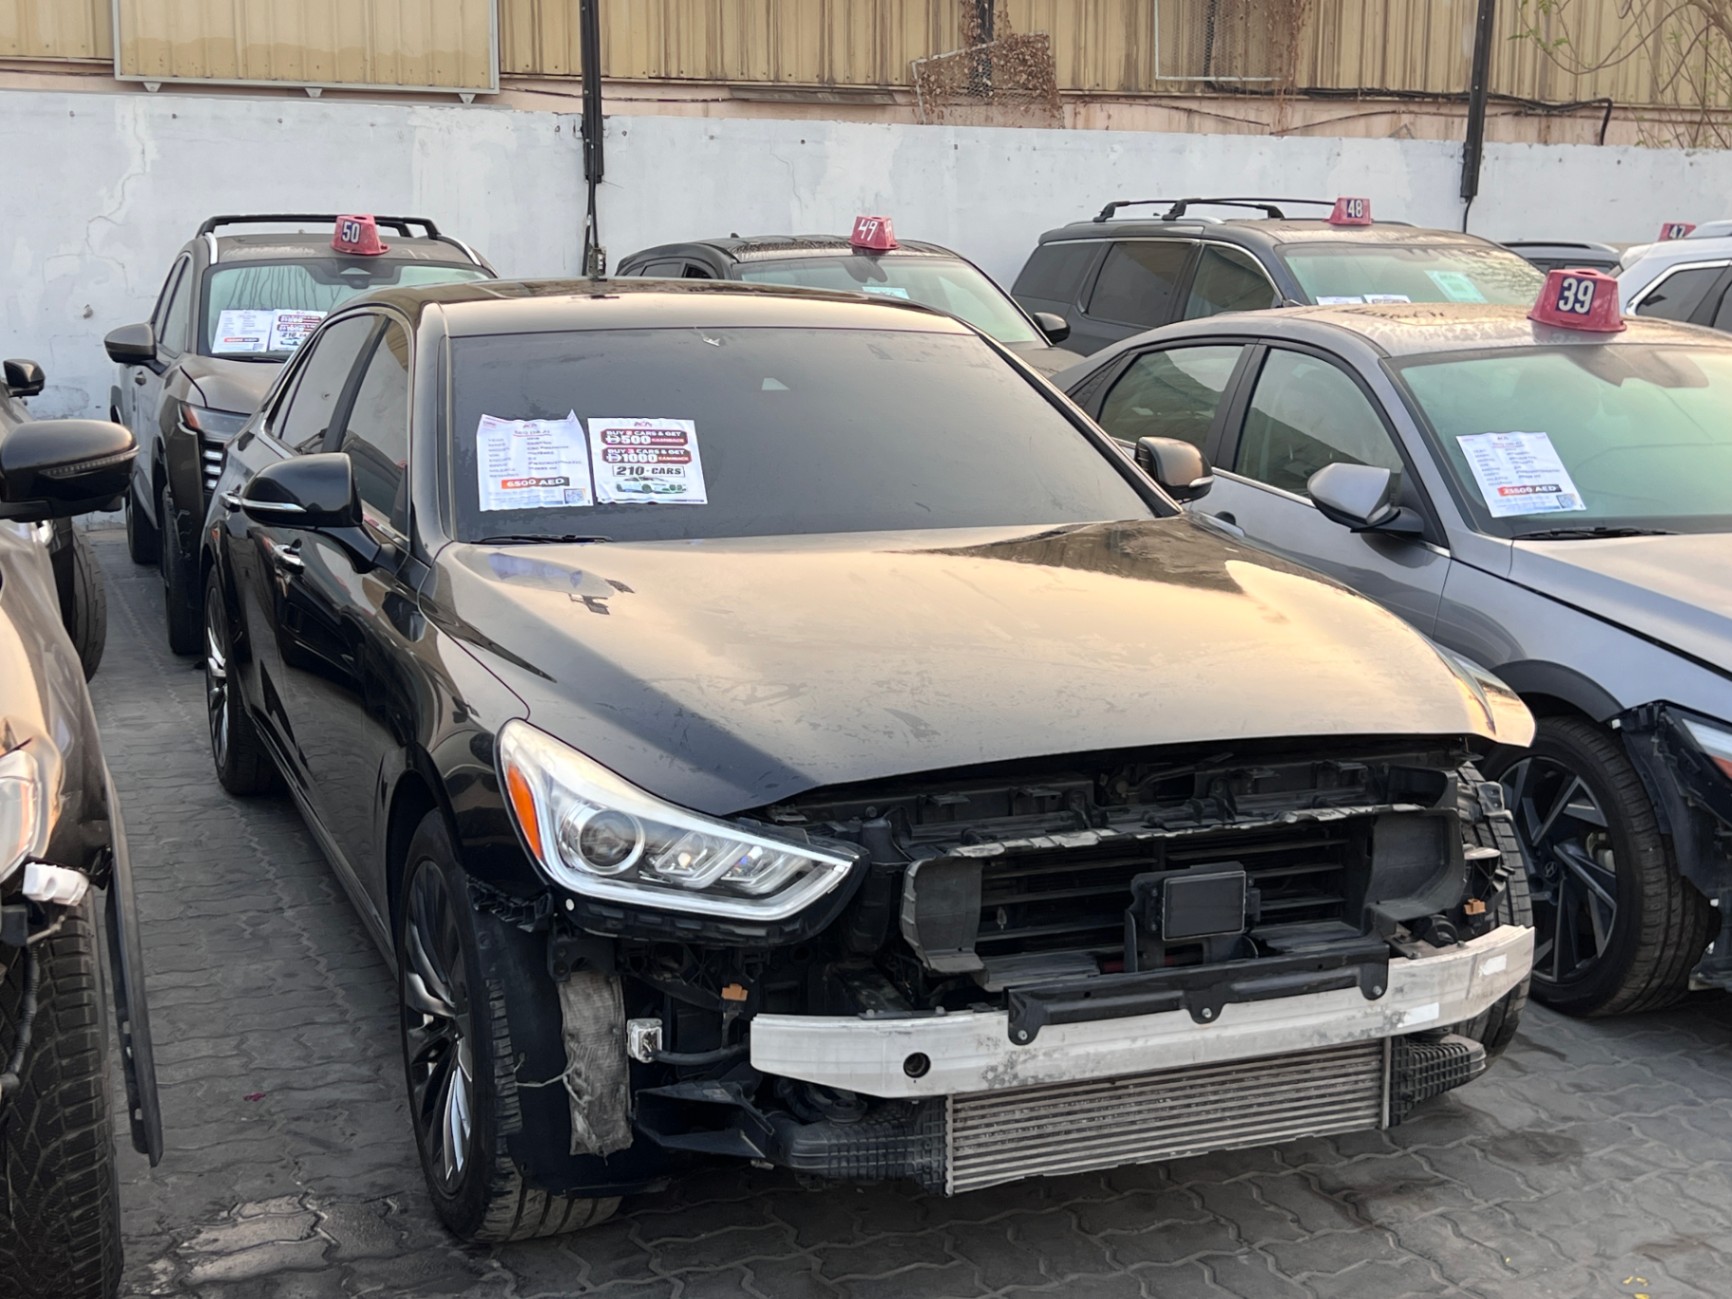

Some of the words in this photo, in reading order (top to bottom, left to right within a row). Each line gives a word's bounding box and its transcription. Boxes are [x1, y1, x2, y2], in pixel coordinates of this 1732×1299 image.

[1347, 199, 1363, 218] 48
[342, 221, 360, 243] 50
[858, 219, 878, 241] 49
[1558, 278, 1594, 314] 39
[616, 466, 645, 476] 210
[651, 467, 682, 475] CARS
[506, 479, 536, 488] 6500
[539, 477, 565, 486] AED
[1536, 485, 1557, 493] AED
